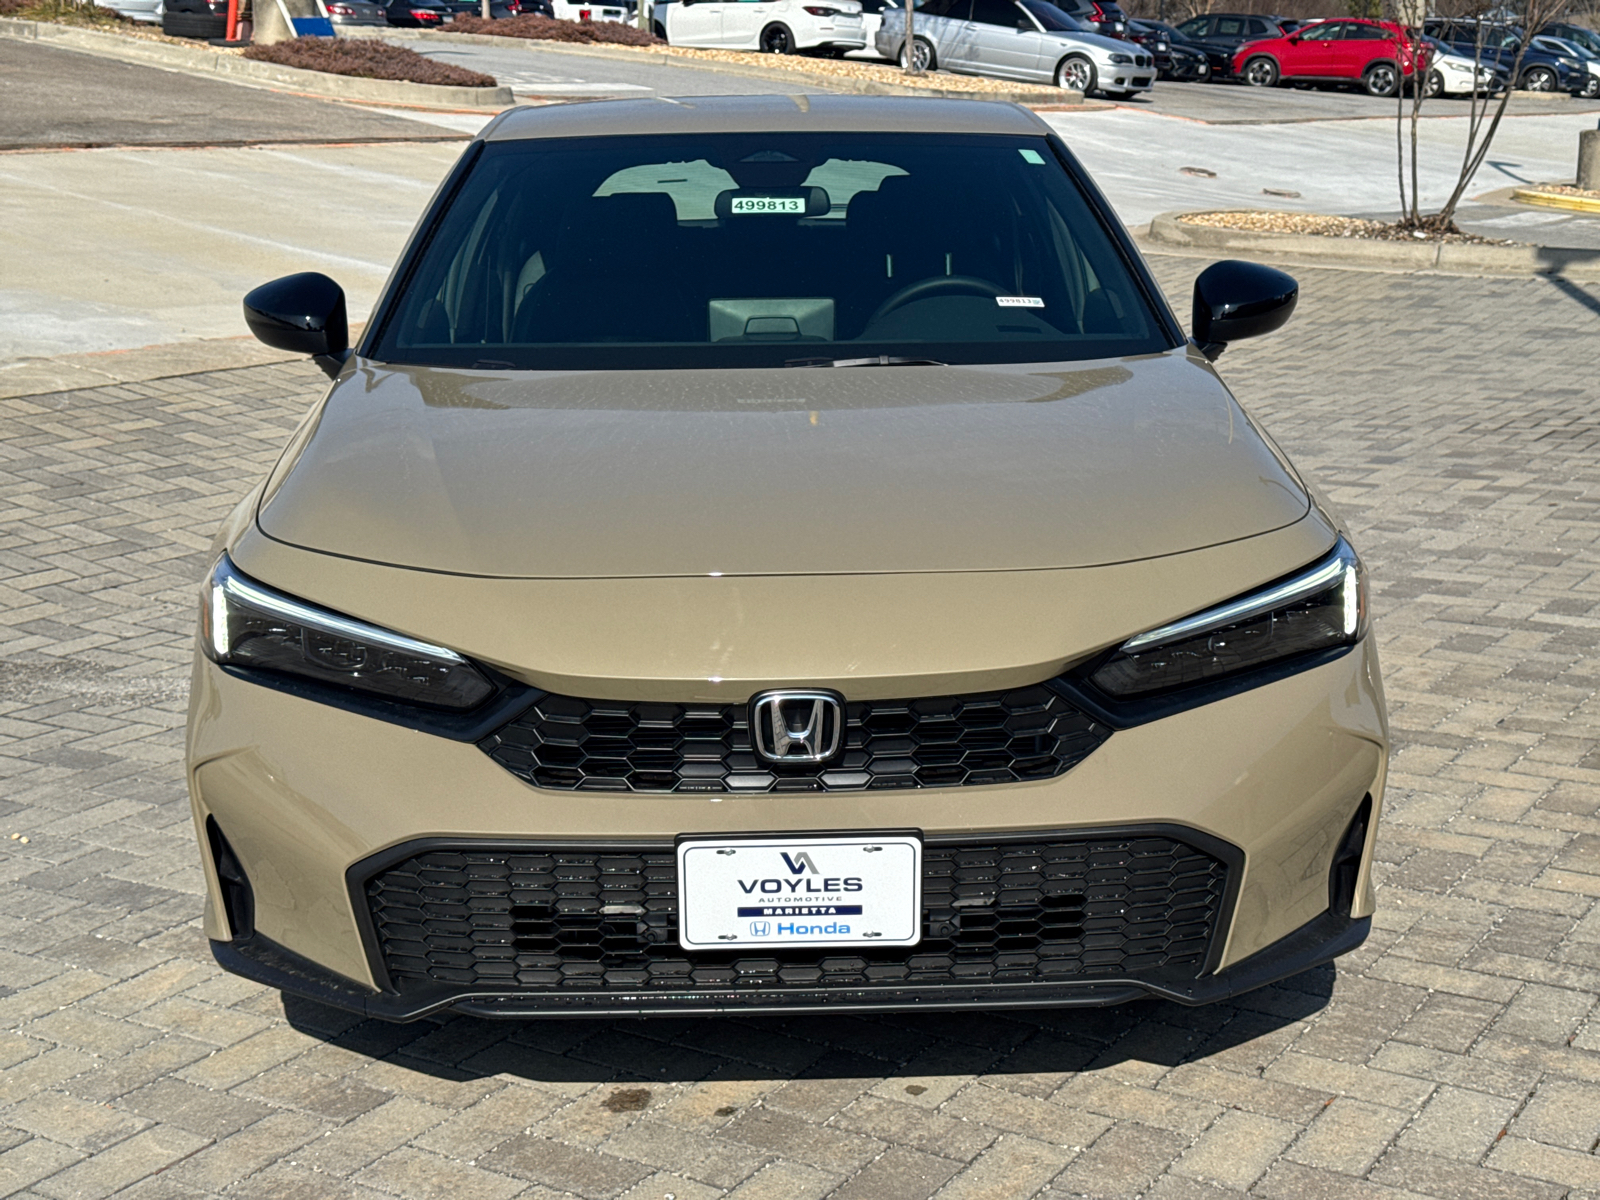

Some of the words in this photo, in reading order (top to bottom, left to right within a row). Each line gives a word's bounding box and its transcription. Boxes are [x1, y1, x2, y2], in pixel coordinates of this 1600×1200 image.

[734, 200, 799, 211] 499813
[737, 877, 863, 894] VOYLES
[763, 907, 837, 915] MARIETTA
[777, 922, 851, 935] Honda
